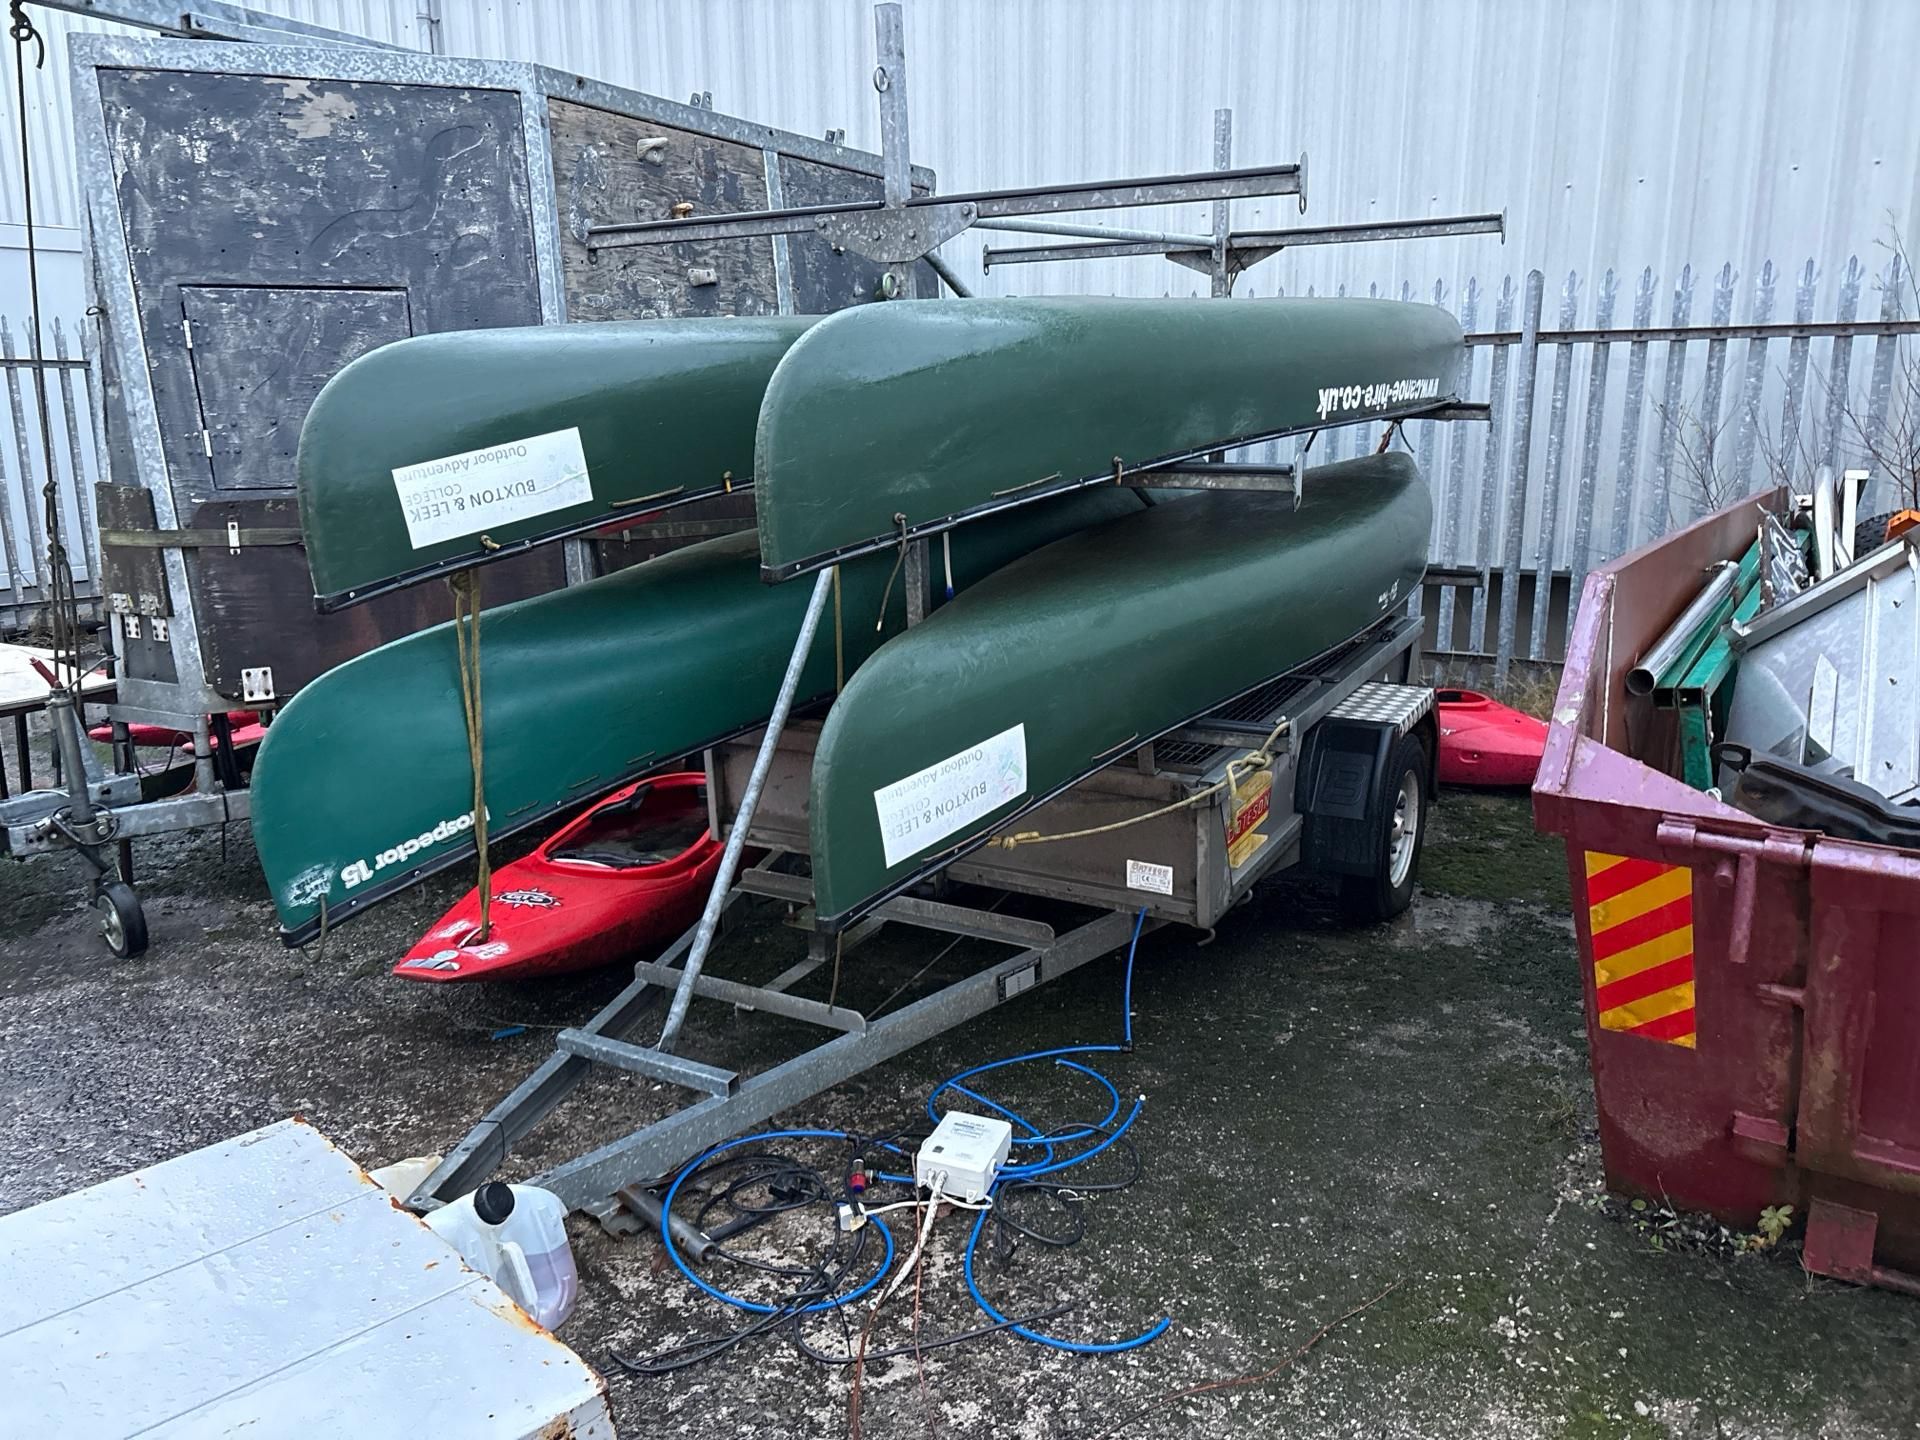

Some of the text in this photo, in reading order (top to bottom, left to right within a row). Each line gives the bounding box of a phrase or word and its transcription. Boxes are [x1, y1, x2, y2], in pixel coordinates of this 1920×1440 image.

[399, 444, 527, 482] Outdoor Adventure
[405, 483, 462, 507] COLLEGE
[408, 479, 536, 524] BUXTON & LEEK
[940, 749, 983, 777] Outdoor
[935, 781, 987, 819] BUXTON
[922, 810, 932, 824] &
[340, 858, 374, 890] 15
